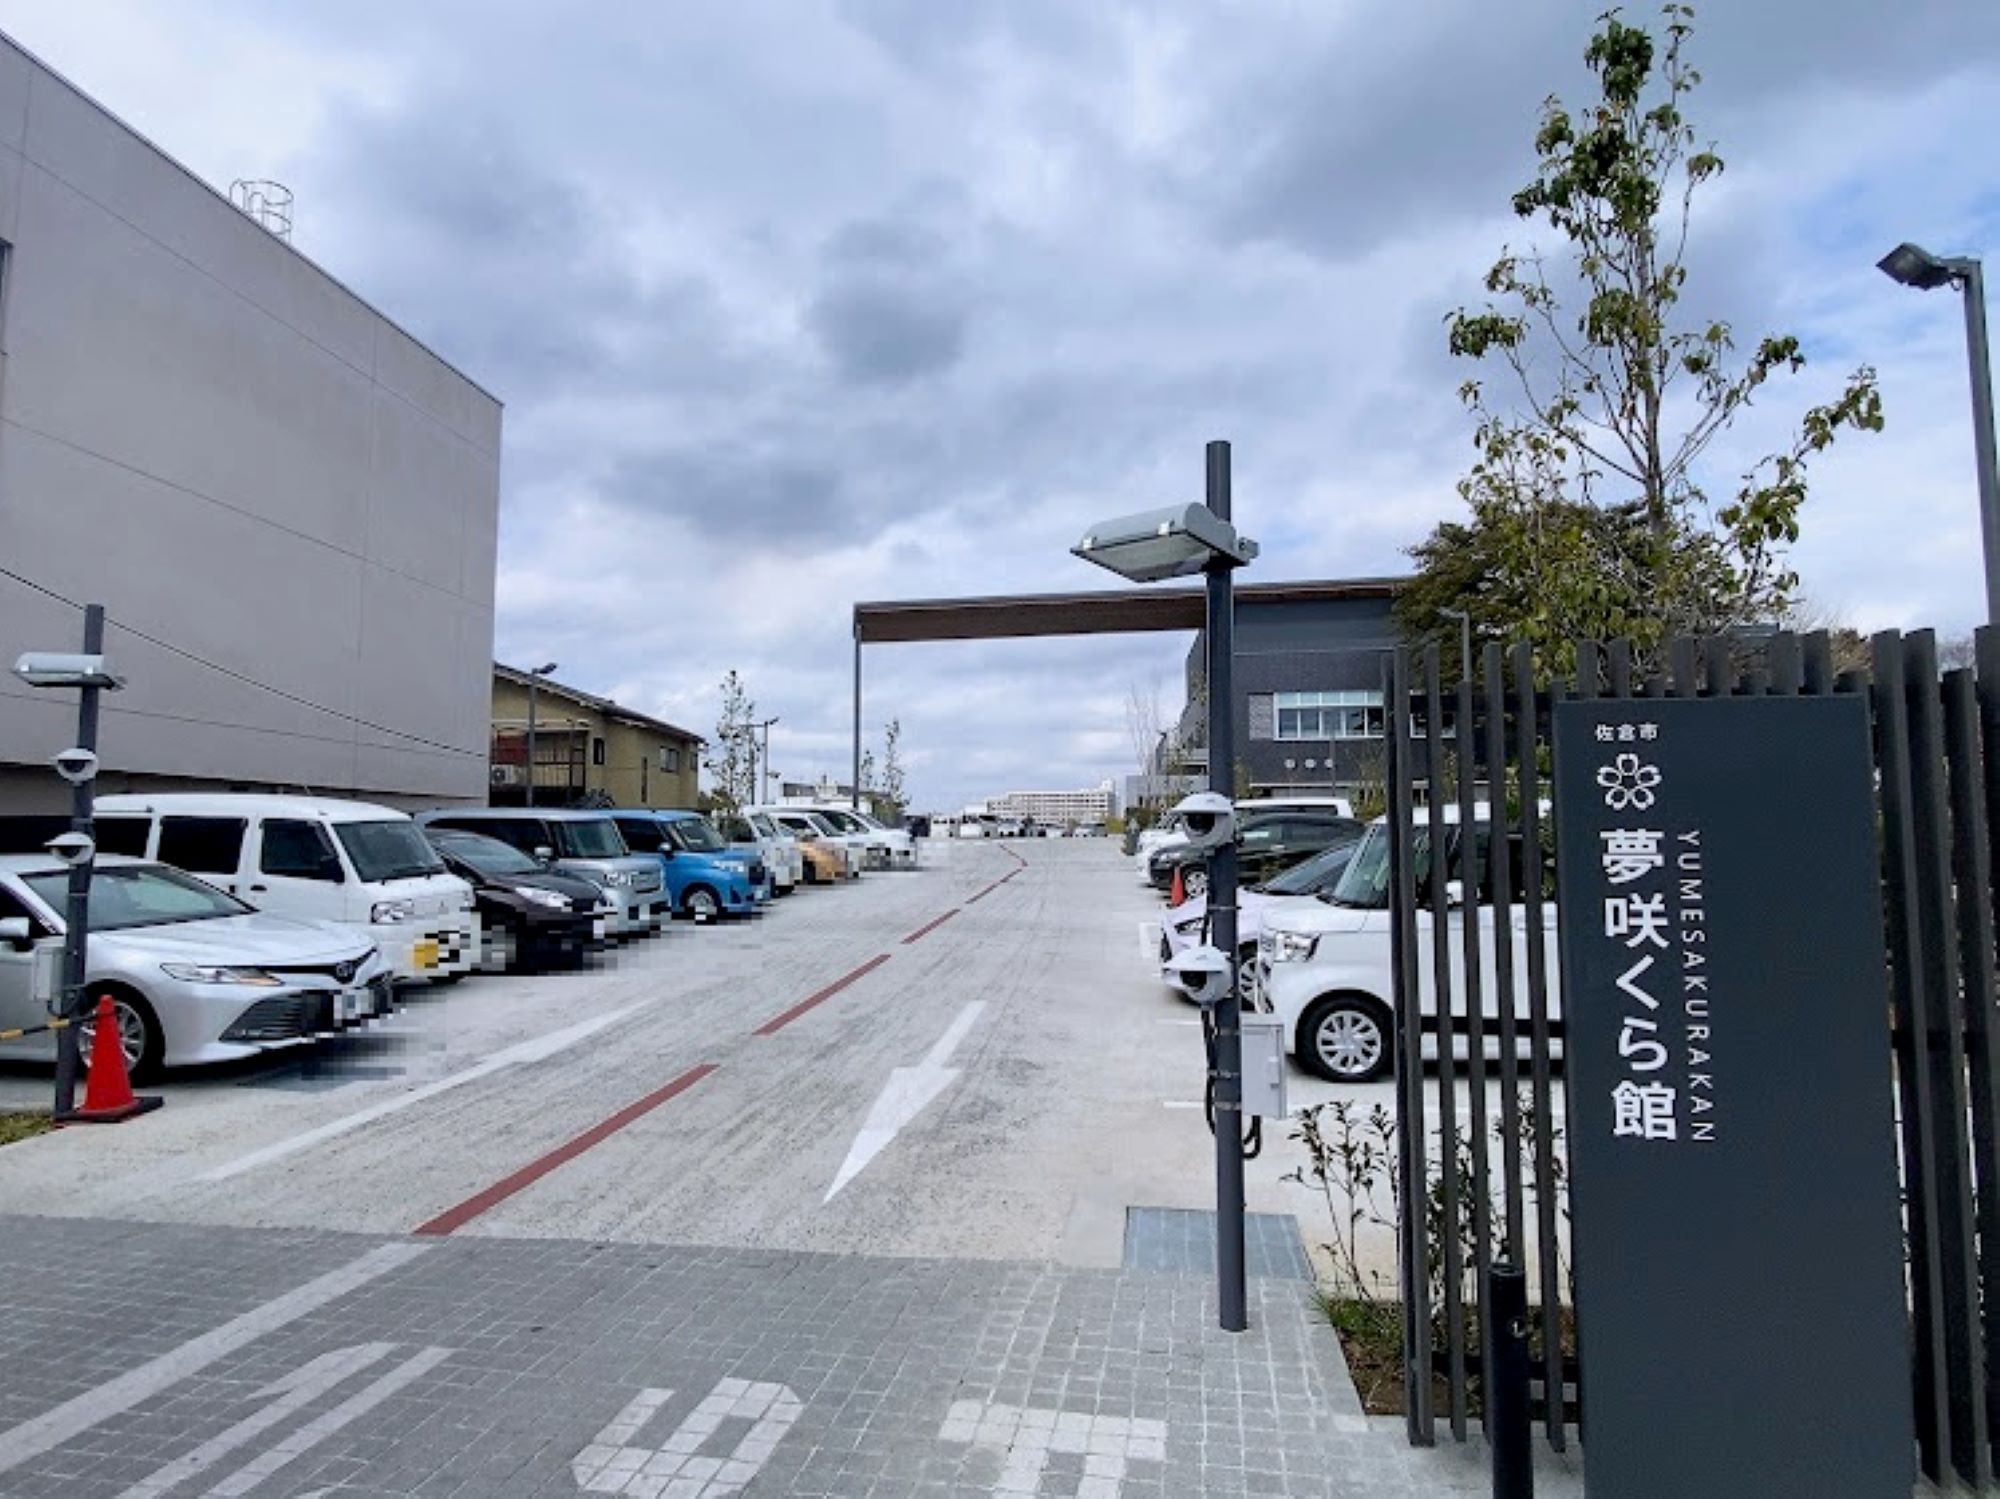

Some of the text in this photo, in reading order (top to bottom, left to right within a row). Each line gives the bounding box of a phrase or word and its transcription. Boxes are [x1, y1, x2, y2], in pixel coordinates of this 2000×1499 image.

[1595, 723, 1658, 741] 佐倉市
[1600, 828, 1677, 1141] 夢咲くら館
[1677, 830, 1716, 1141] YUMESAKURAKAN
